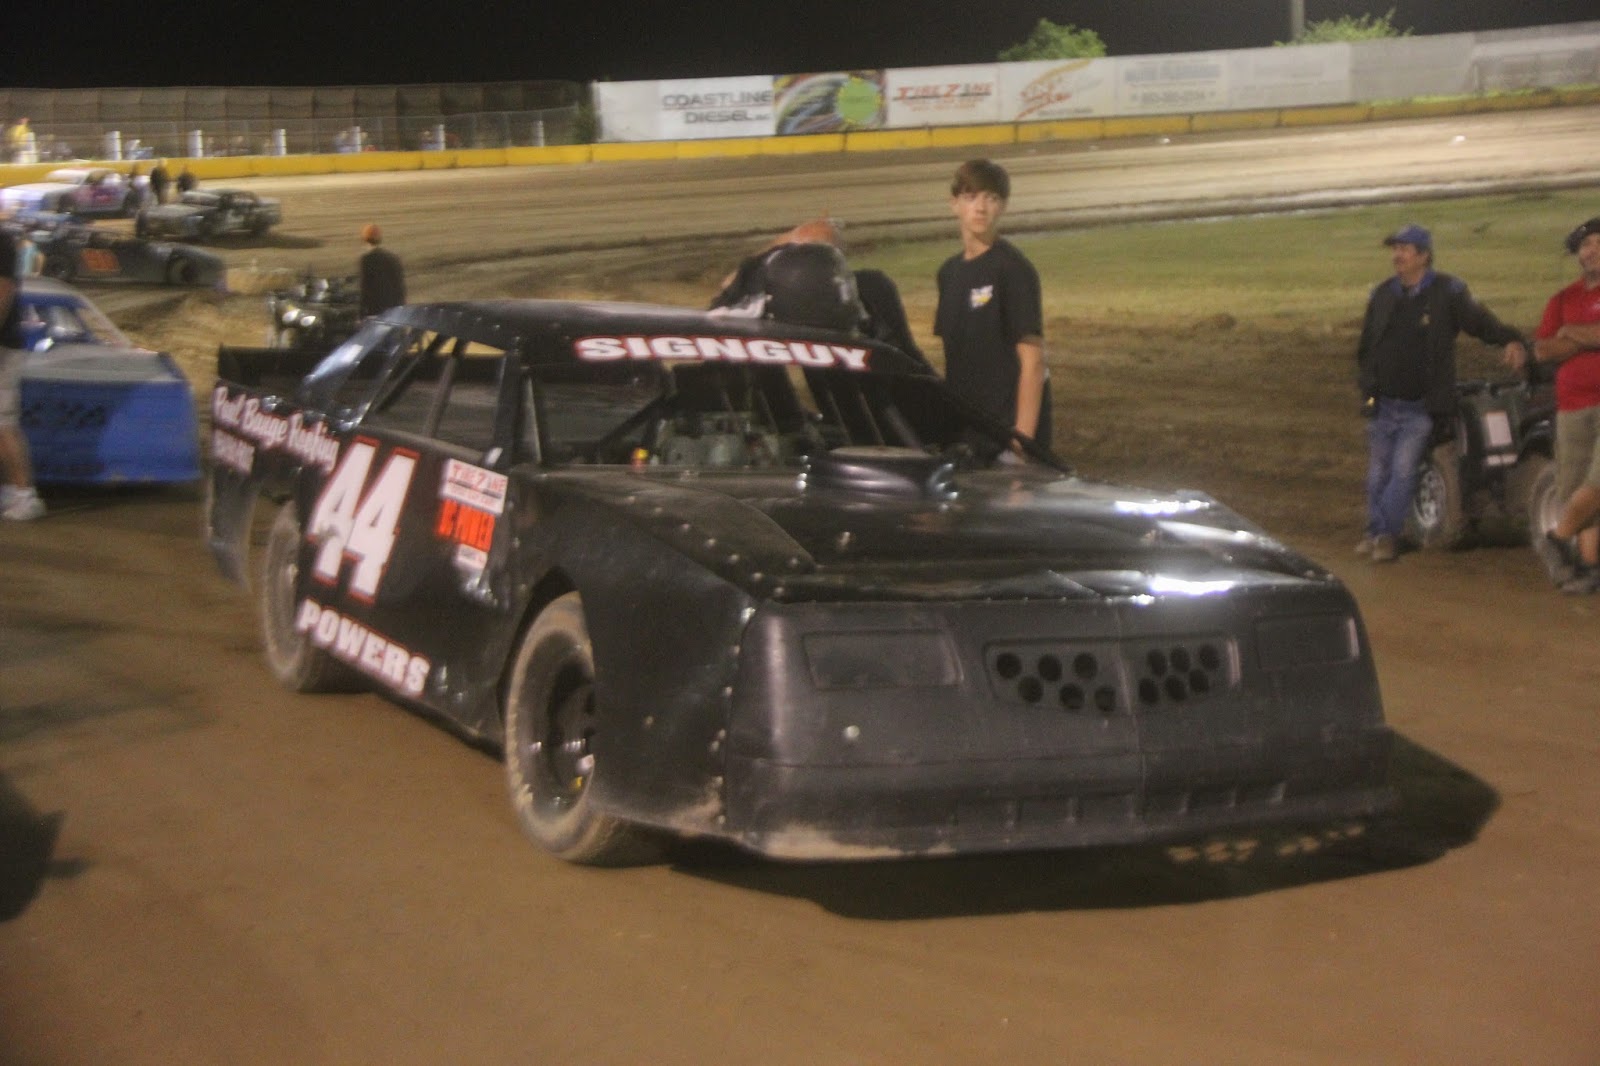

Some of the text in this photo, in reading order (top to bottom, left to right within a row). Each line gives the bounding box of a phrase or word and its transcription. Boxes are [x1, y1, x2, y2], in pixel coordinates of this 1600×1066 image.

[576, 335, 869, 370] SIGNGUY
[307, 437, 419, 602] 44
[297, 599, 431, 696] POWERS
